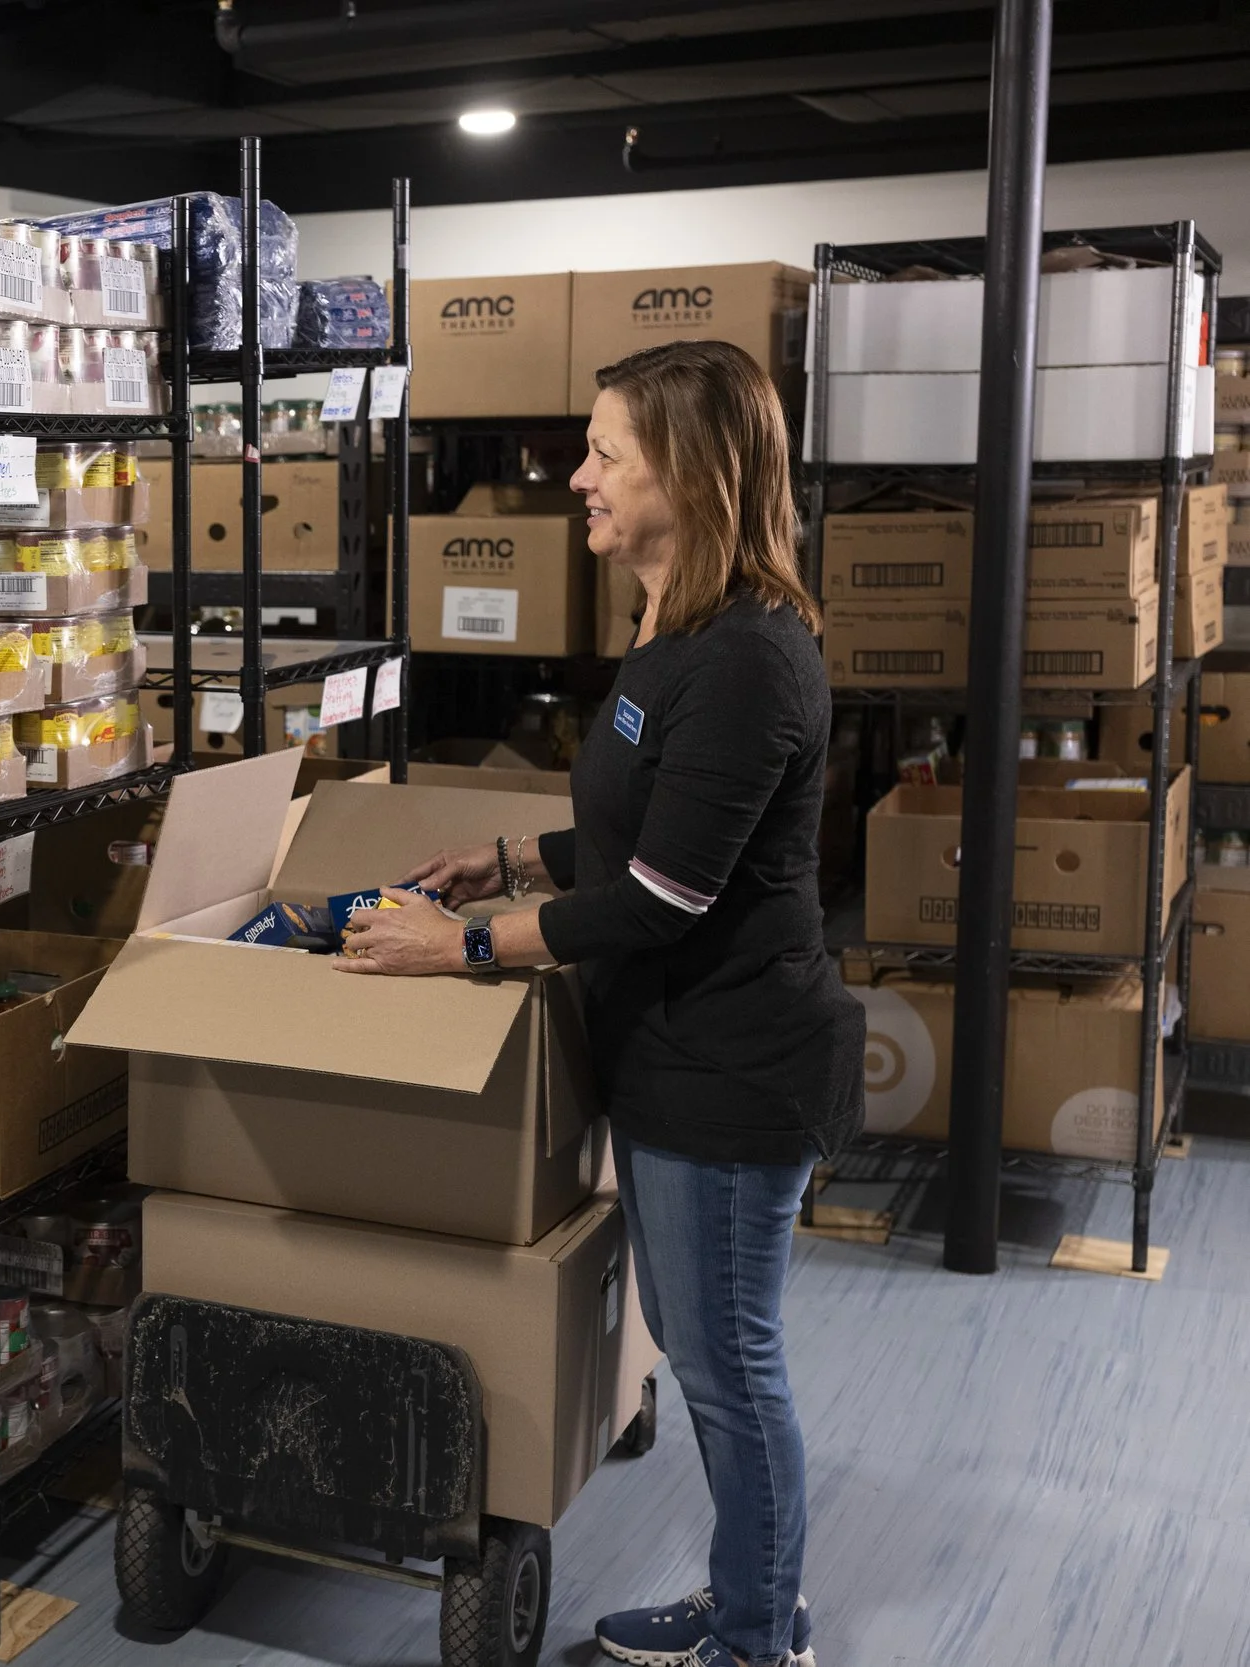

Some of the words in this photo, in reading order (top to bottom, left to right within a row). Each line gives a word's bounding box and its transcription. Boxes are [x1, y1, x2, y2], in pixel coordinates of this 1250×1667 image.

[632, 310, 713, 323] THEATRES
[441, 318, 515, 330] THEATRES
[1086, 1104, 1108, 1116] DO
